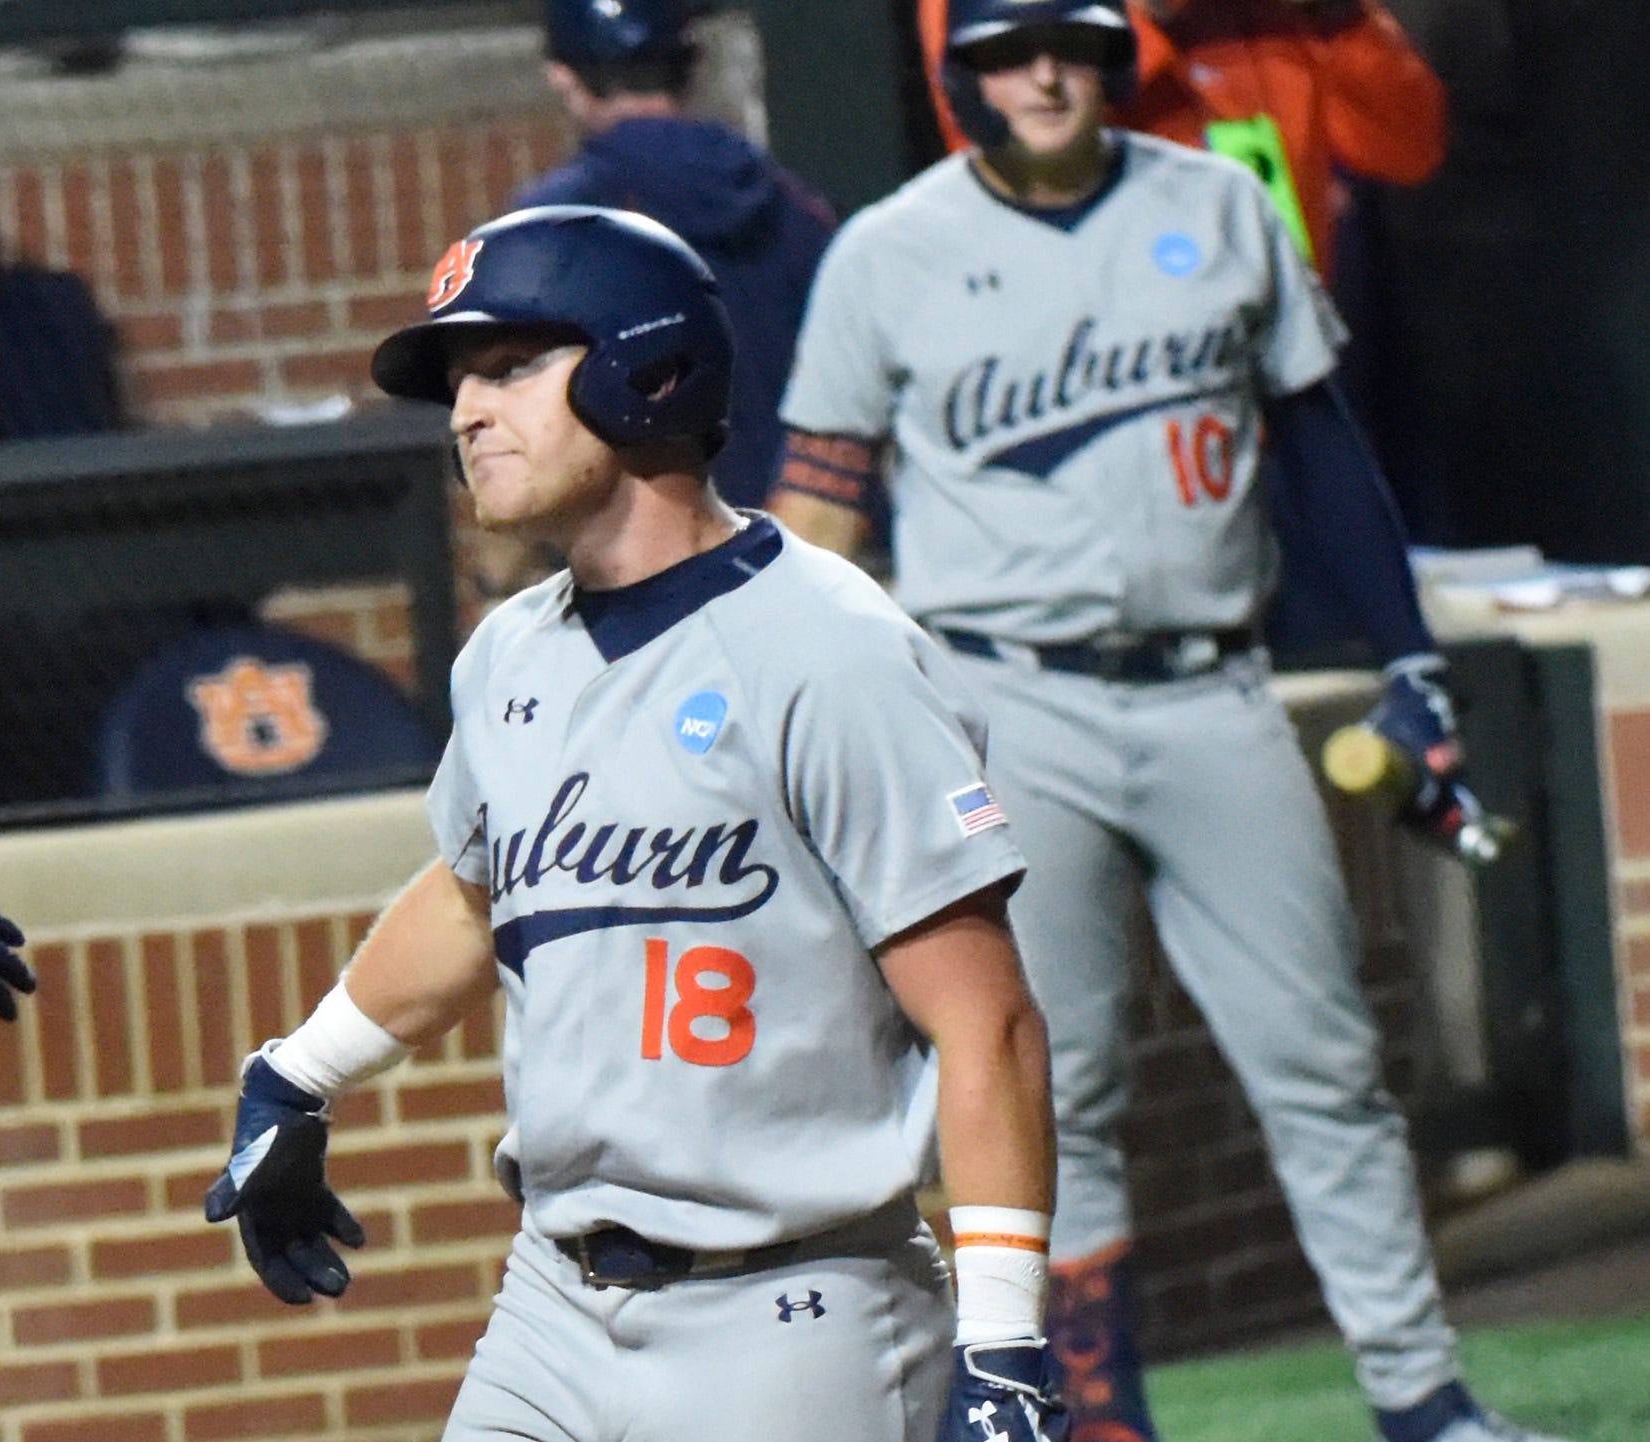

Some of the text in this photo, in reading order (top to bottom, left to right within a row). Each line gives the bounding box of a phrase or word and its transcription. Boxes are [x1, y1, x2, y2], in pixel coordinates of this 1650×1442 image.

[944, 315, 1235, 452] Auburn
[1166, 414, 1233, 506] 10
[640, 935, 756, 1067] 18
